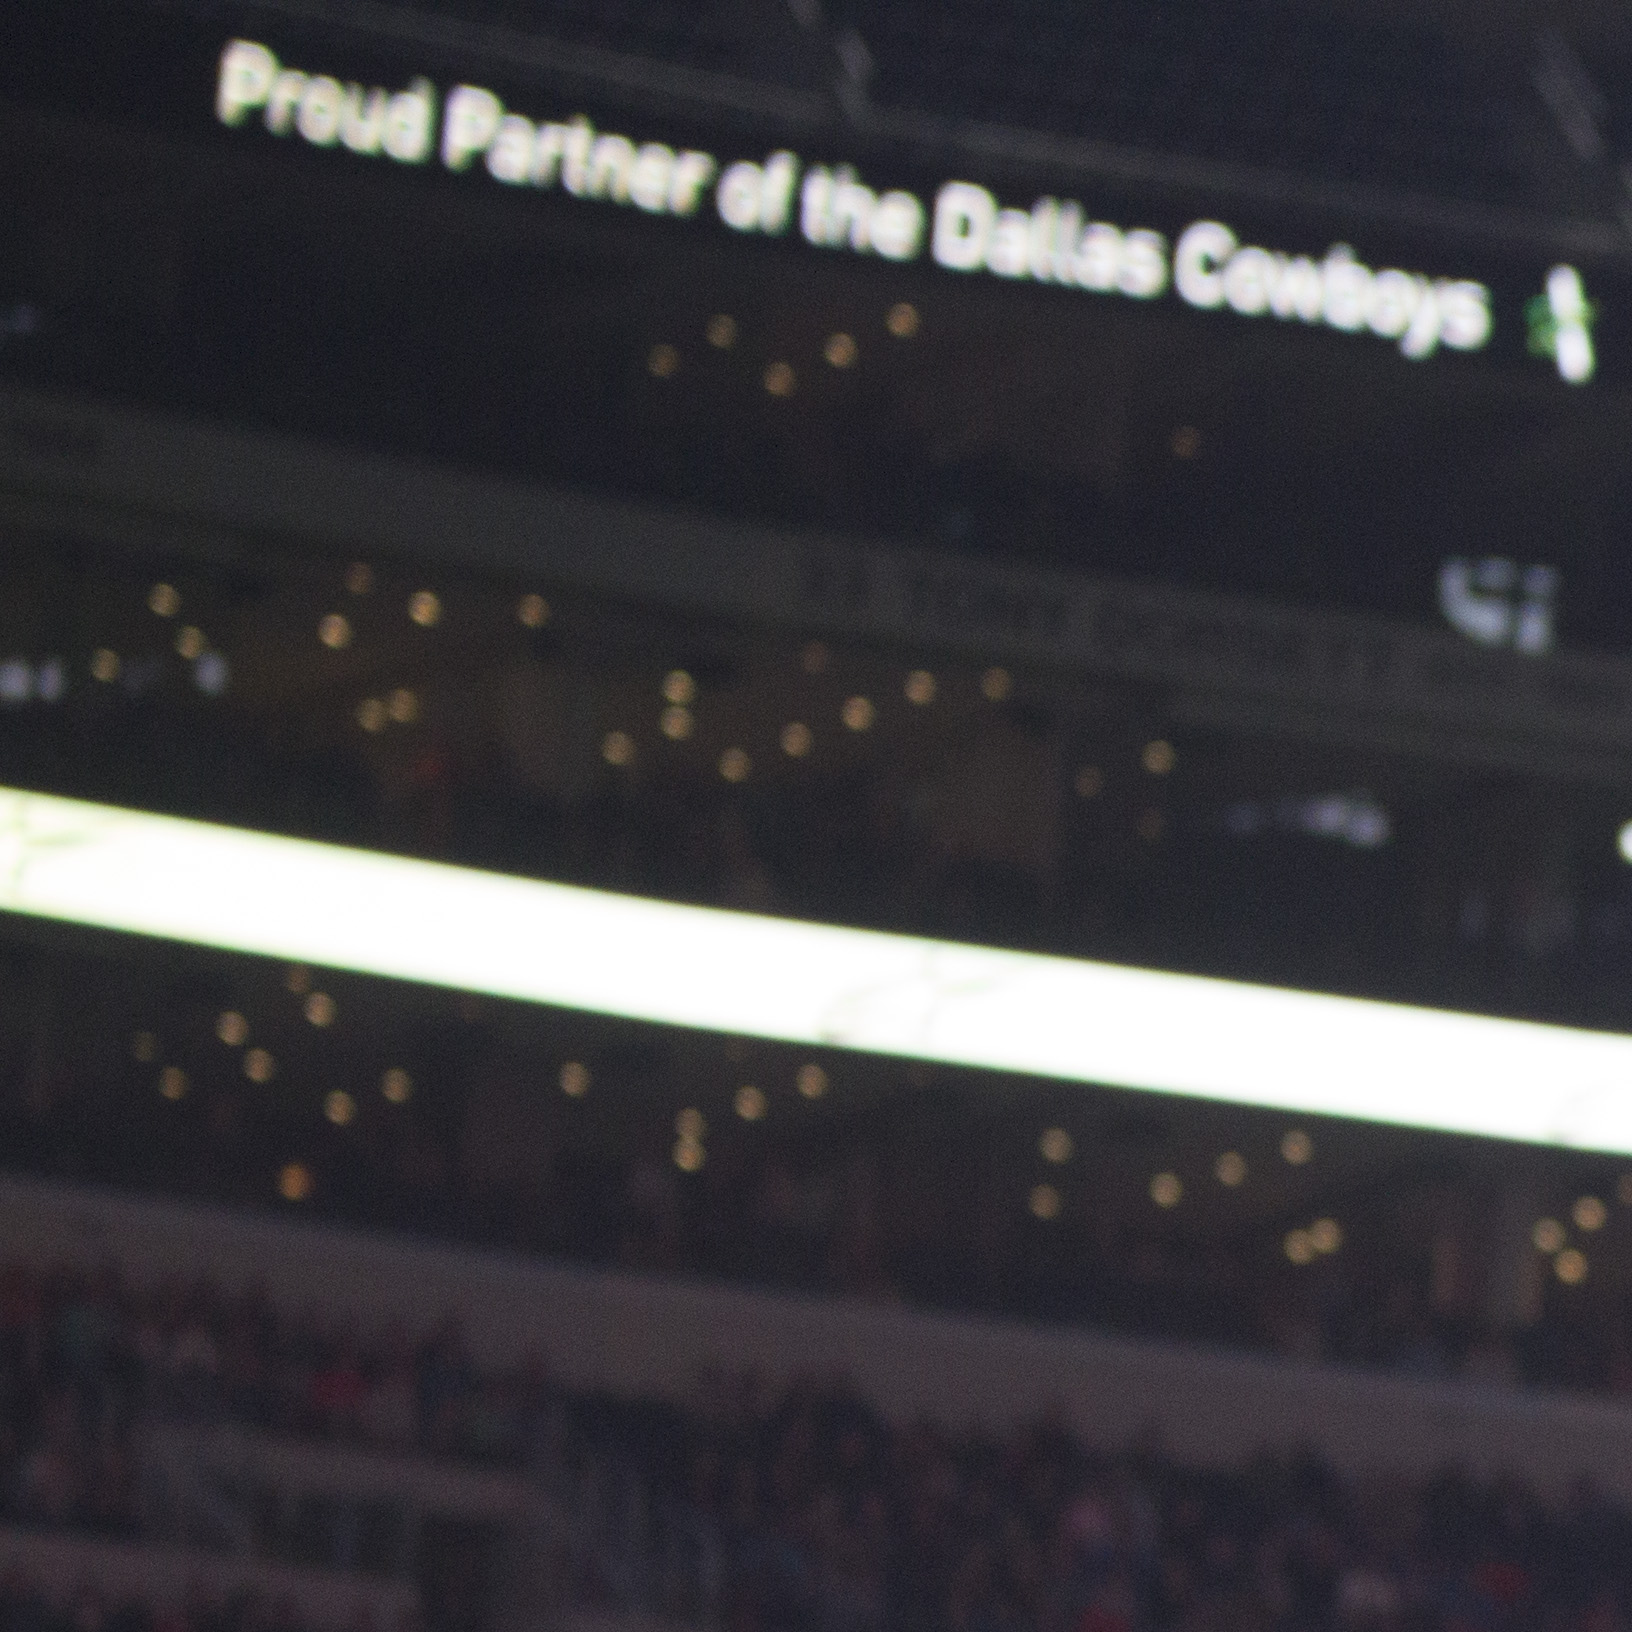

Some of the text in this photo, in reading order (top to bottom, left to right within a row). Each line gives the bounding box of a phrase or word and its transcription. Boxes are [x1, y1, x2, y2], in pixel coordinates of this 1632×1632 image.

[217, 40, 1491, 359] Proud Partner of the Dallas Cowboys
